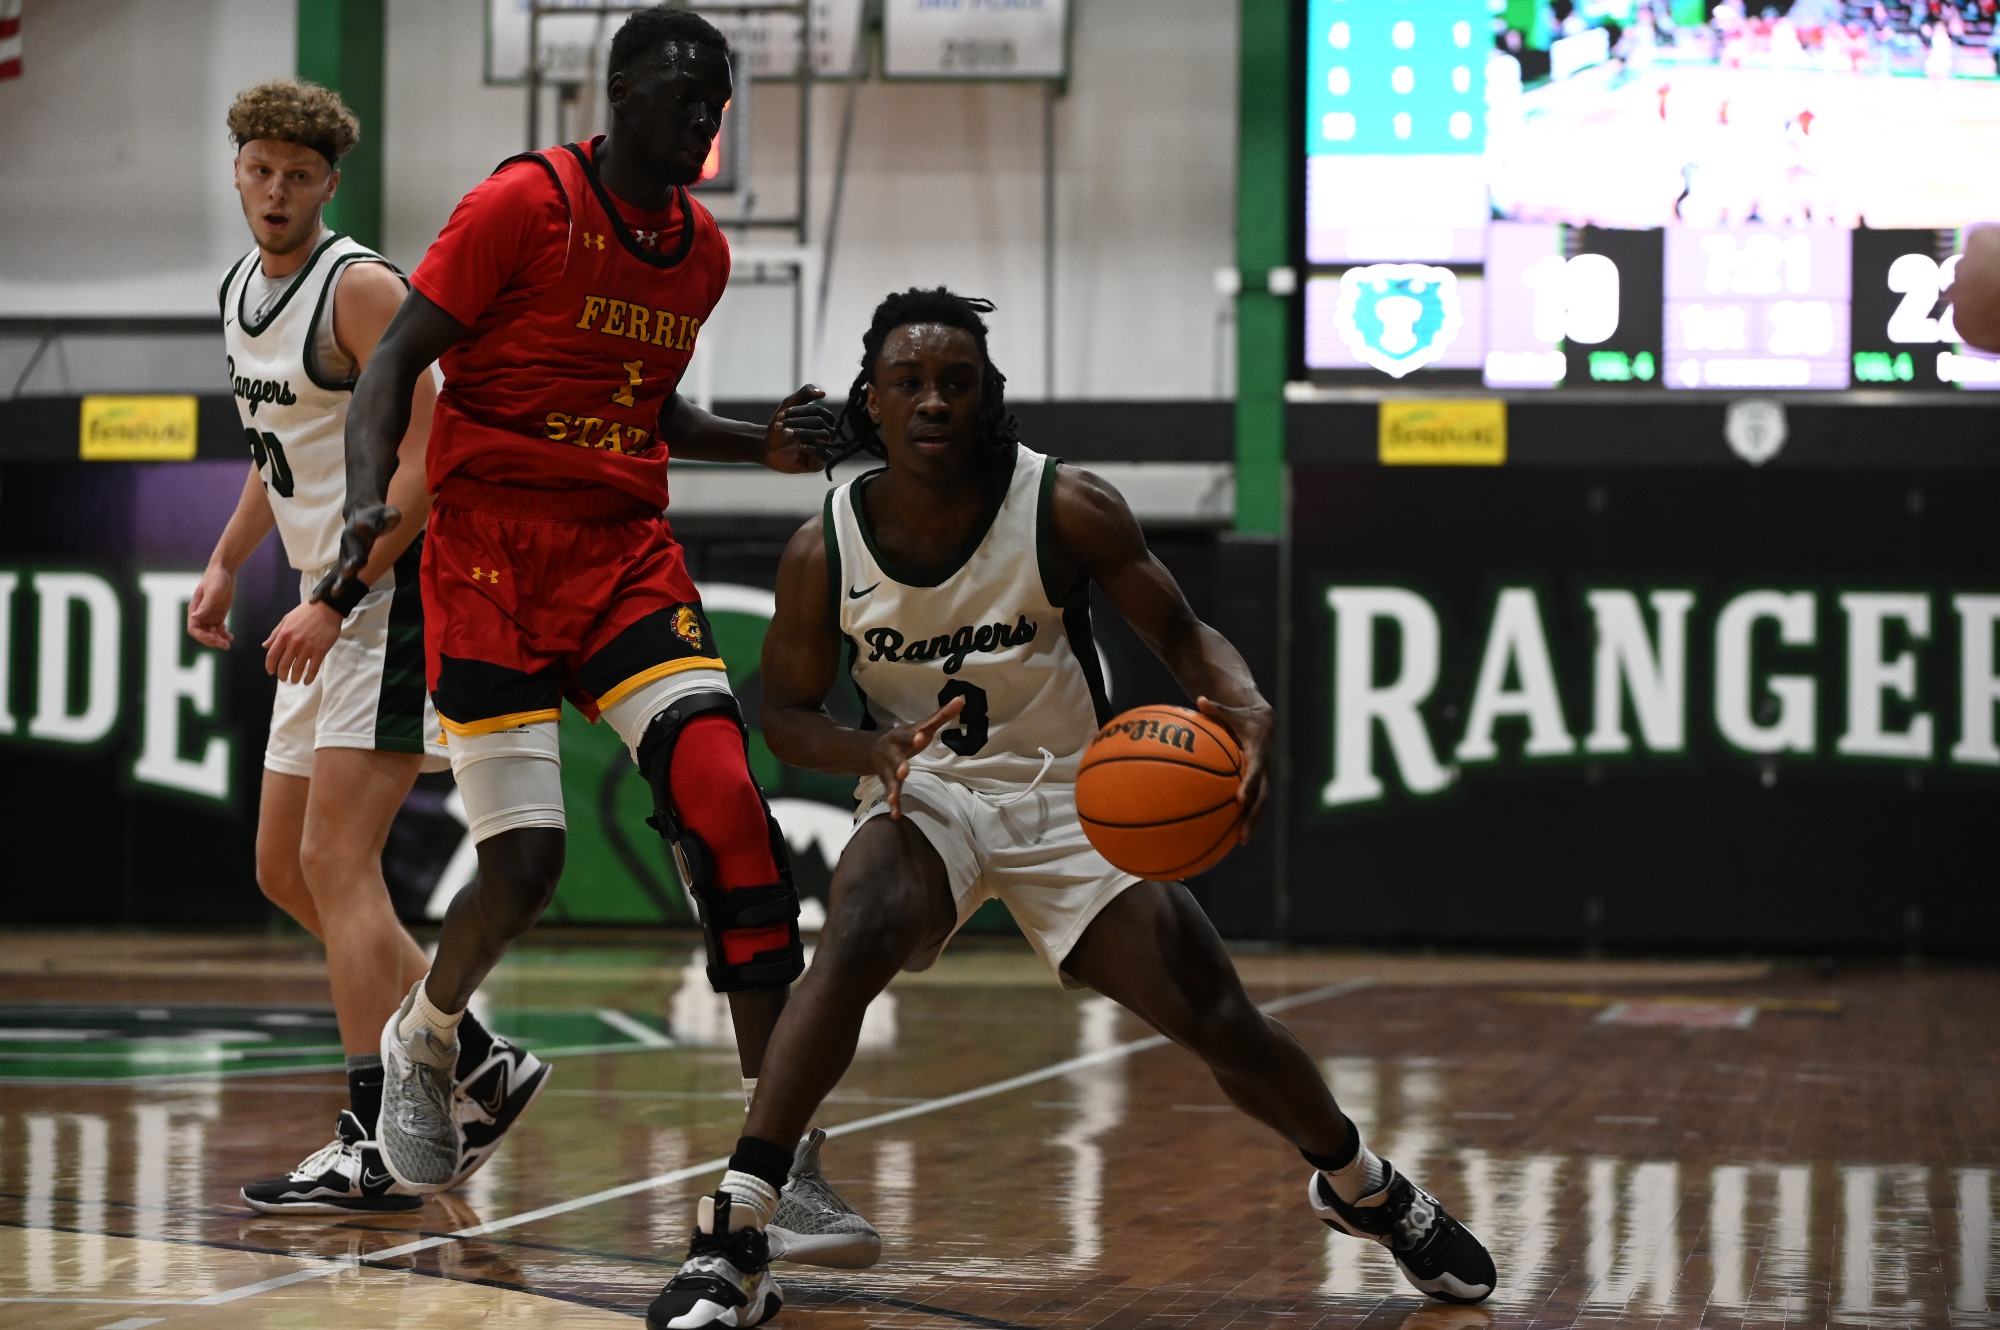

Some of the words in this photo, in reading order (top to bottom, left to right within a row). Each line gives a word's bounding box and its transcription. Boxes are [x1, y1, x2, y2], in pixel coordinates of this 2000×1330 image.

[576, 295, 700, 351] FERRIS
[611, 359, 644, 408] 1
[544, 411, 651, 456] STAT
[864, 614, 1037, 675] Rangers
[937, 679, 989, 757] 3
